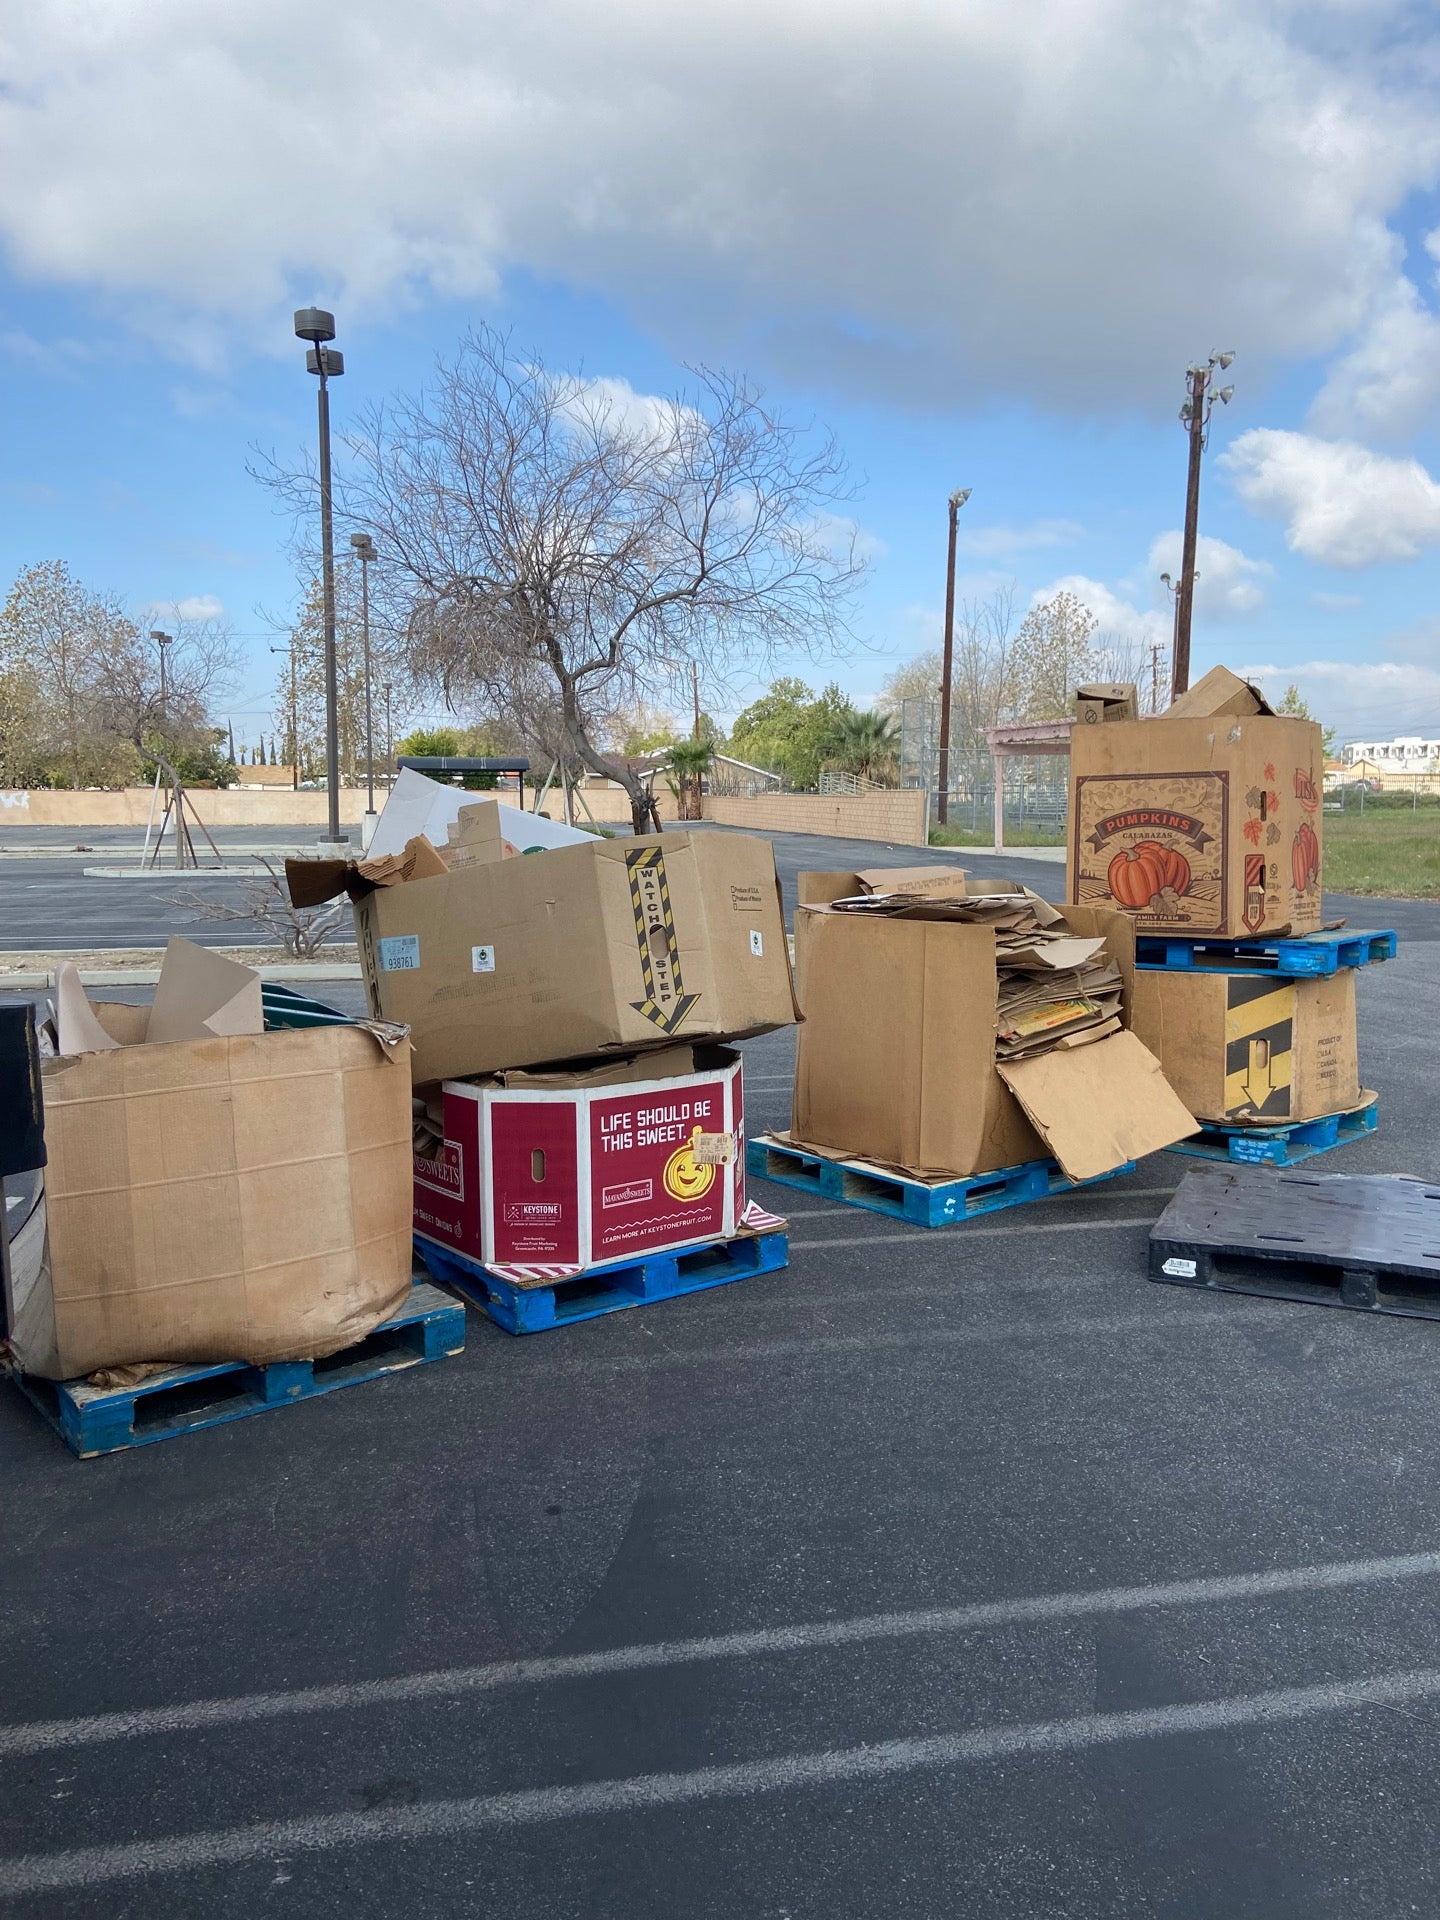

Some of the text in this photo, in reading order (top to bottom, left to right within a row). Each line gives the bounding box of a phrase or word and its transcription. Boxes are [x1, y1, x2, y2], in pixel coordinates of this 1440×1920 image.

[1106, 813, 1191, 831] PUMPKINS
[641, 870, 671, 1002] WATCH STEP
[388, 956, 414, 970] 938761
[1318, 1036, 1336, 1046] PRODUCT
[1321, 1059, 1337, 1068] CANADA
[1320, 1070, 1336, 1078] MEXICO
[601, 1100, 711, 1133] LIFE SHOULD BE
[601, 1132, 633, 1152] THIS
[637, 1123, 686, 1146] SWEET.
[426, 1161, 460, 1186] SWEETS
[605, 1187, 650, 1203] MAYAN SWEETS
[523, 1206, 558, 1214] KEYSTONE
[420, 1209, 434, 1224] SWEET
[436, 1217, 452, 1232] ONIONS
[602, 1234, 621, 1244] LEARN
[622, 1230, 638, 1238] MORE
[648, 1215, 712, 1234] KEYSTONEFRUIT.COM
